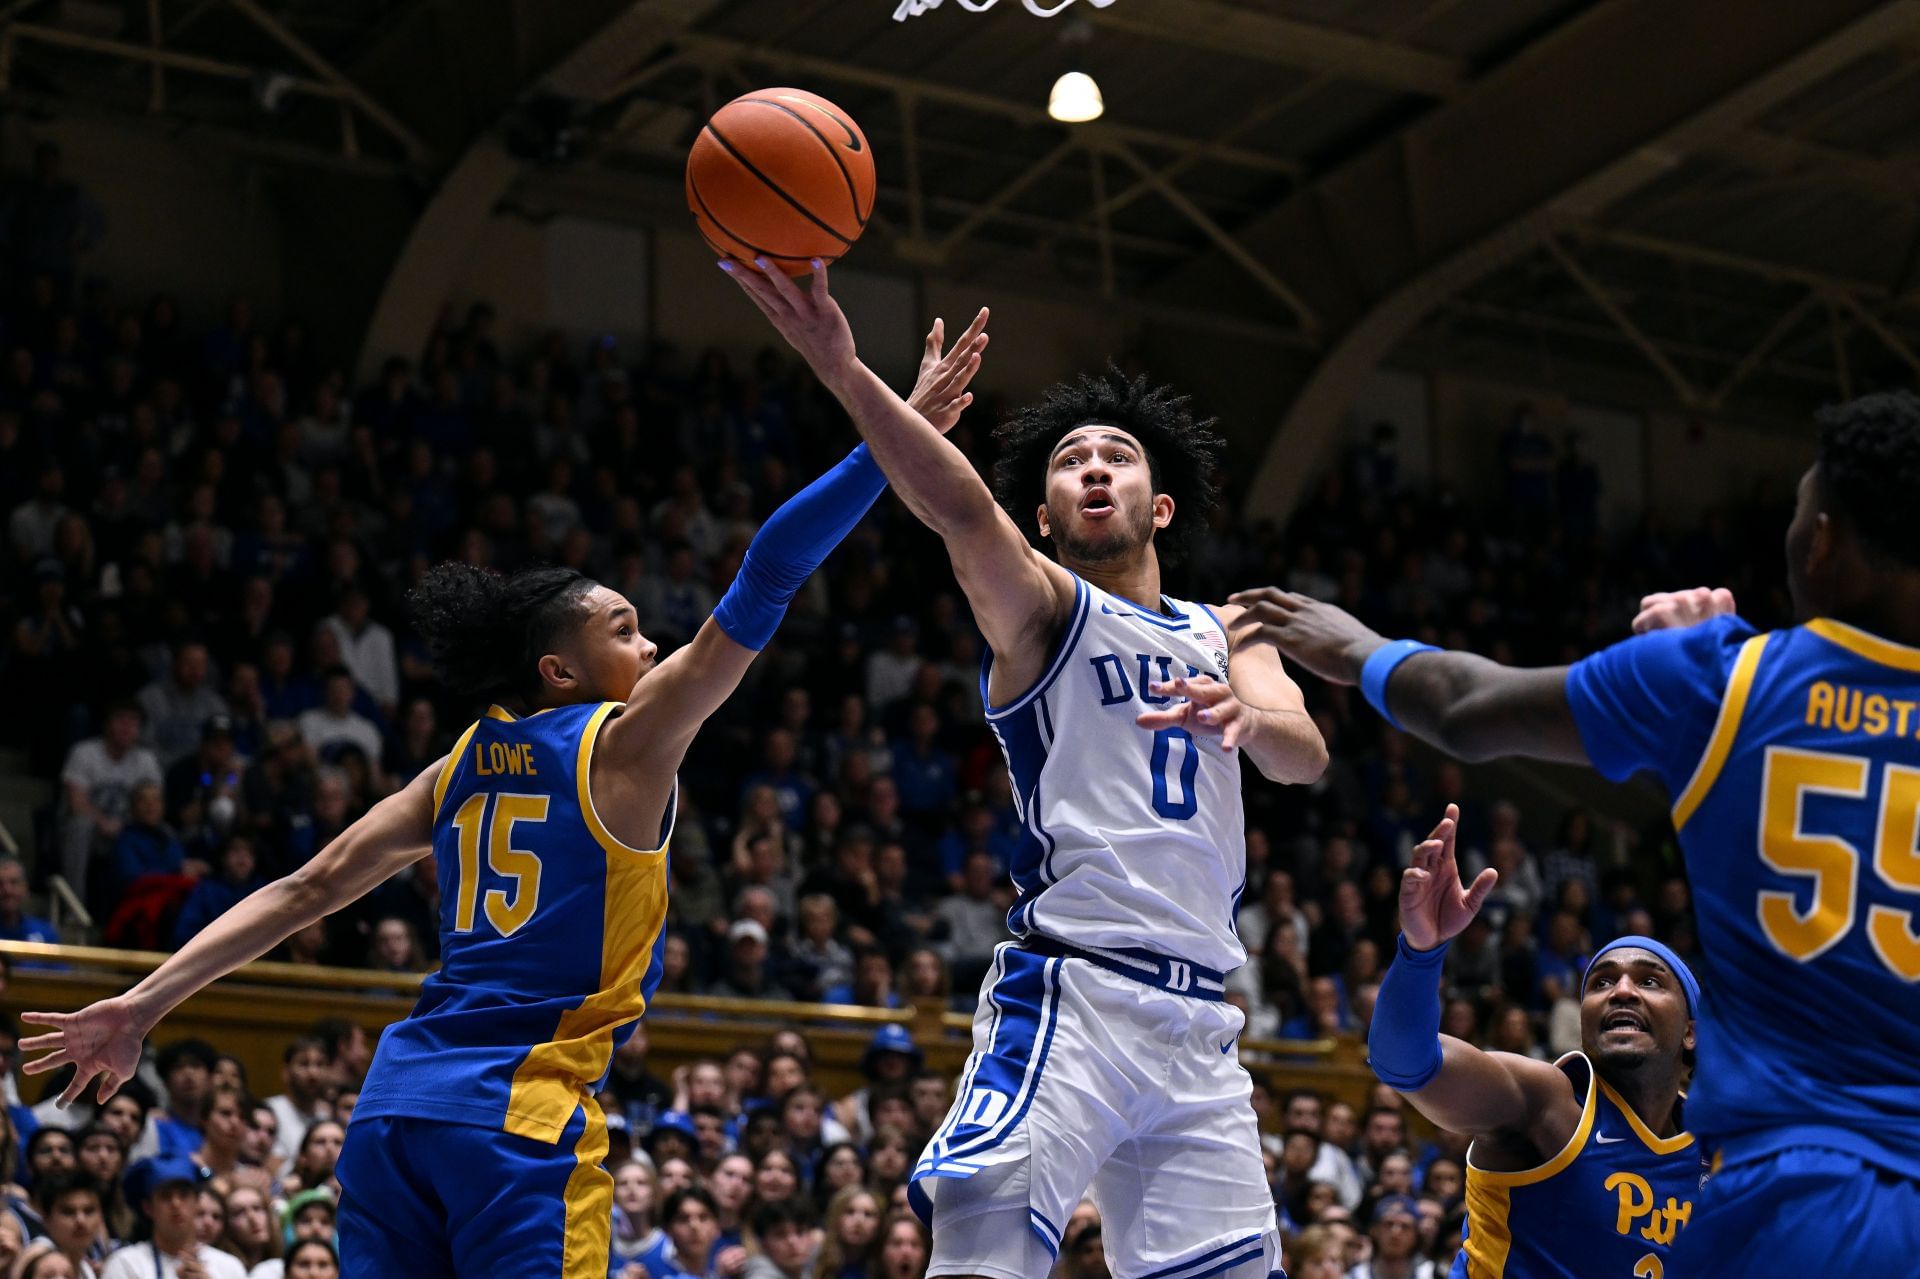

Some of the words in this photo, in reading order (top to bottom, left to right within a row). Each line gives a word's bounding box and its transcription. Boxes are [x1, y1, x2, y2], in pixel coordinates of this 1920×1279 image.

[1090, 653, 1219, 706] DU
[1805, 681, 1920, 741] AUST
[475, 742, 537, 776] LOWE
[1150, 727, 1199, 820] 0
[451, 792, 550, 938] 15
[1166, 960, 1191, 992] D
[959, 1088, 1008, 1127] D
